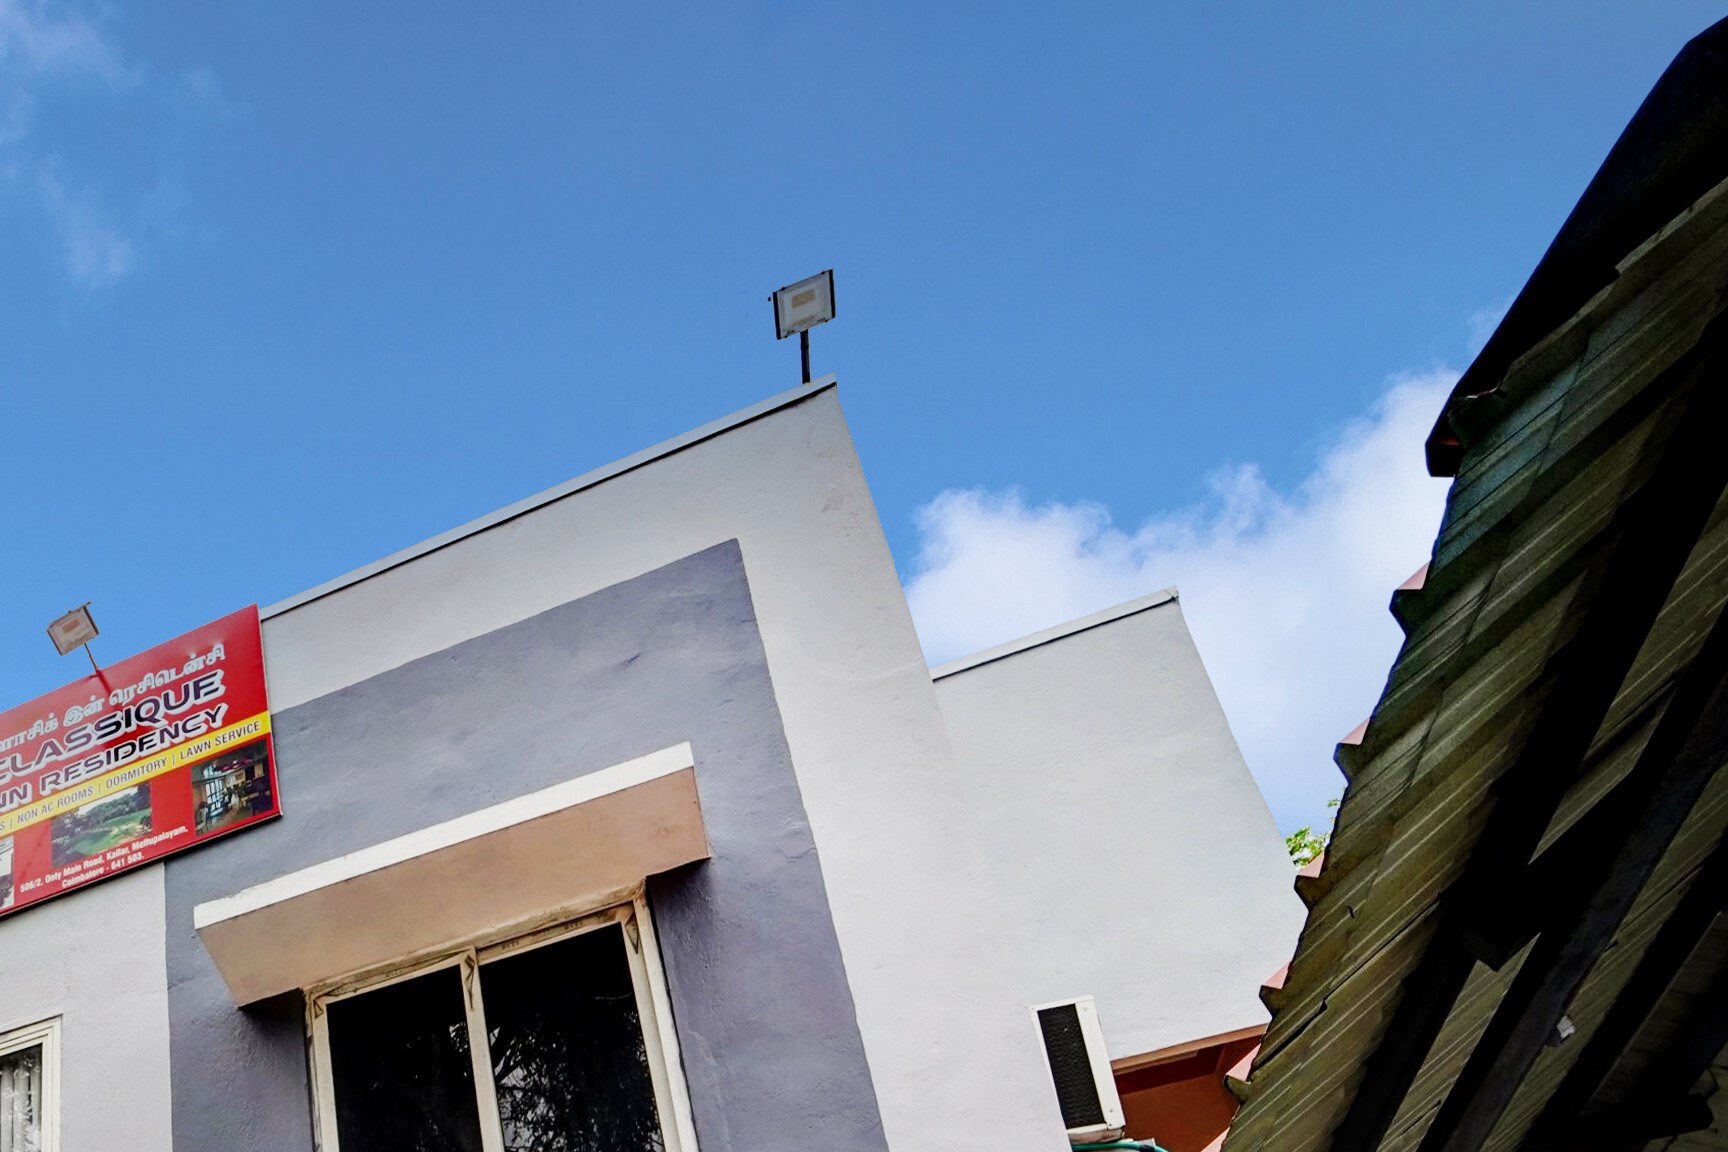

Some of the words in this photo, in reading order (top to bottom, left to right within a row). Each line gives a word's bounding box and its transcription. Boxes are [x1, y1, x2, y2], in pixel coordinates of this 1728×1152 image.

[39, 703, 229, 795] RESIDENCY
[62, 694, 105, 727] இன்
[17, 808, 38, 824] NON
[41, 801, 55, 814] AC
[57, 786, 94, 808] ROOMS
[106, 757, 168, 789] DORMITORY
[180, 740, 212, 760] LAWN
[215, 720, 261, 746] SERVICE
